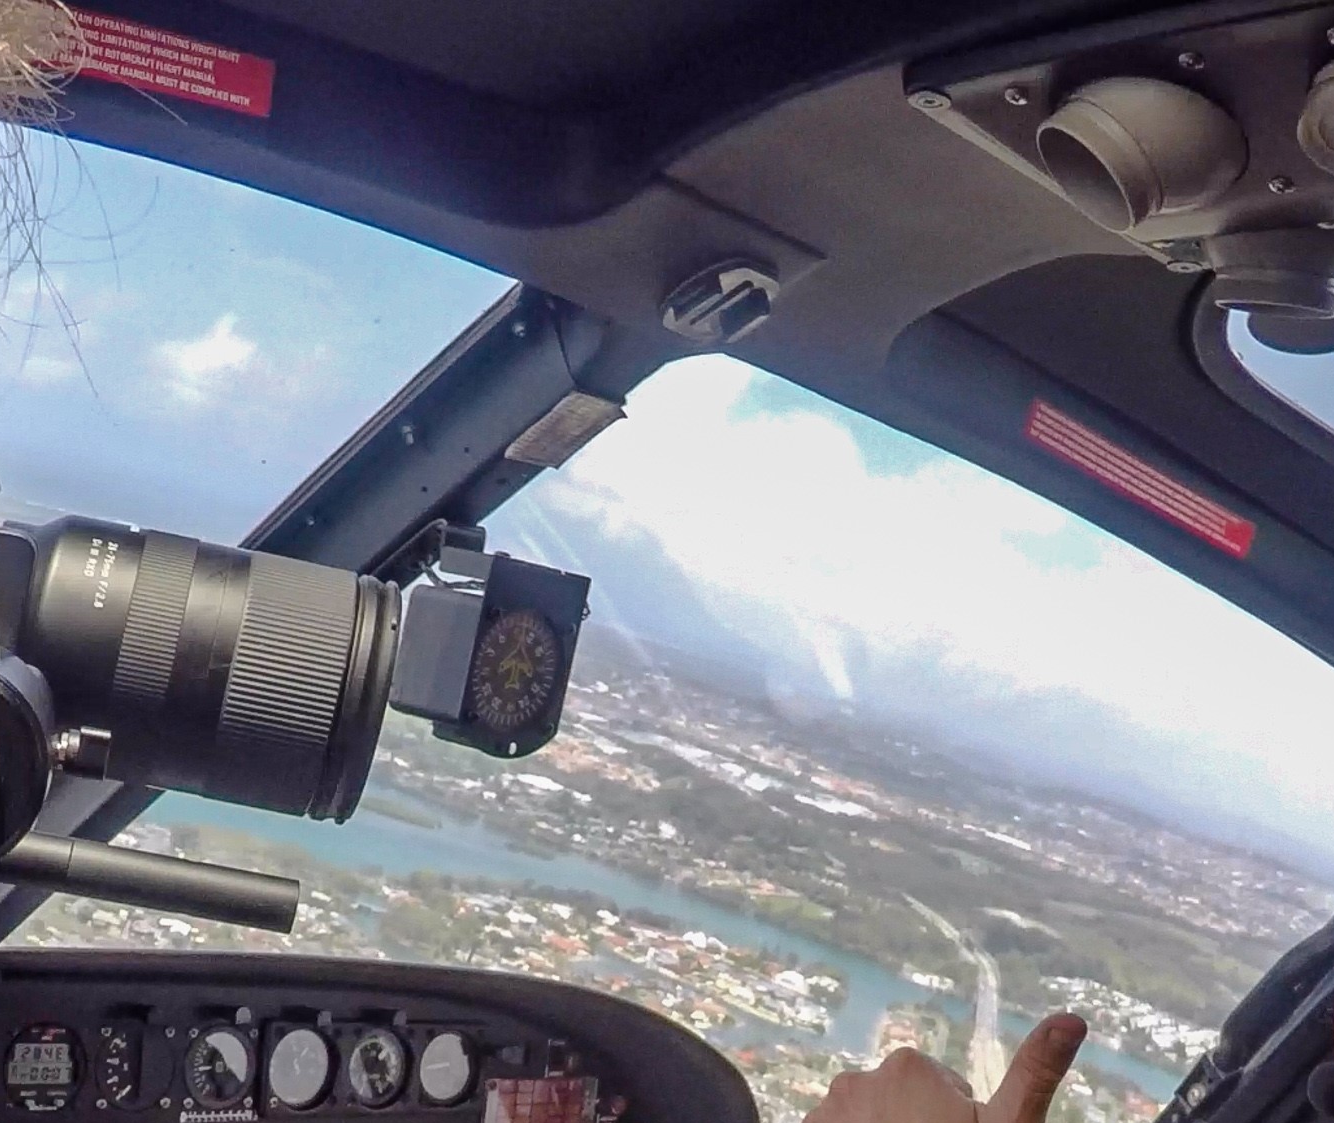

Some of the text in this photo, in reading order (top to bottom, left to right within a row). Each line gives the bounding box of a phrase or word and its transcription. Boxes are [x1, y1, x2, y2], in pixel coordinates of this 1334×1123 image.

[93, 16, 139, 37] OPERATING
[140, 28, 190, 50] LIMITATIONS
[190, 42, 217, 57] WHICH
[218, 48, 240, 64] MUST
[100, 33, 152, 54] LIMITATIONS
[152, 46, 179, 60] WHICH
[180, 53, 203, 67] MUST
[104, 48, 155, 69] ROTORCRAFT
[155, 60, 182, 76] FLIGHT
[155, 74, 178, 88] MUST
[190, 83, 229, 101] COMPLIED
